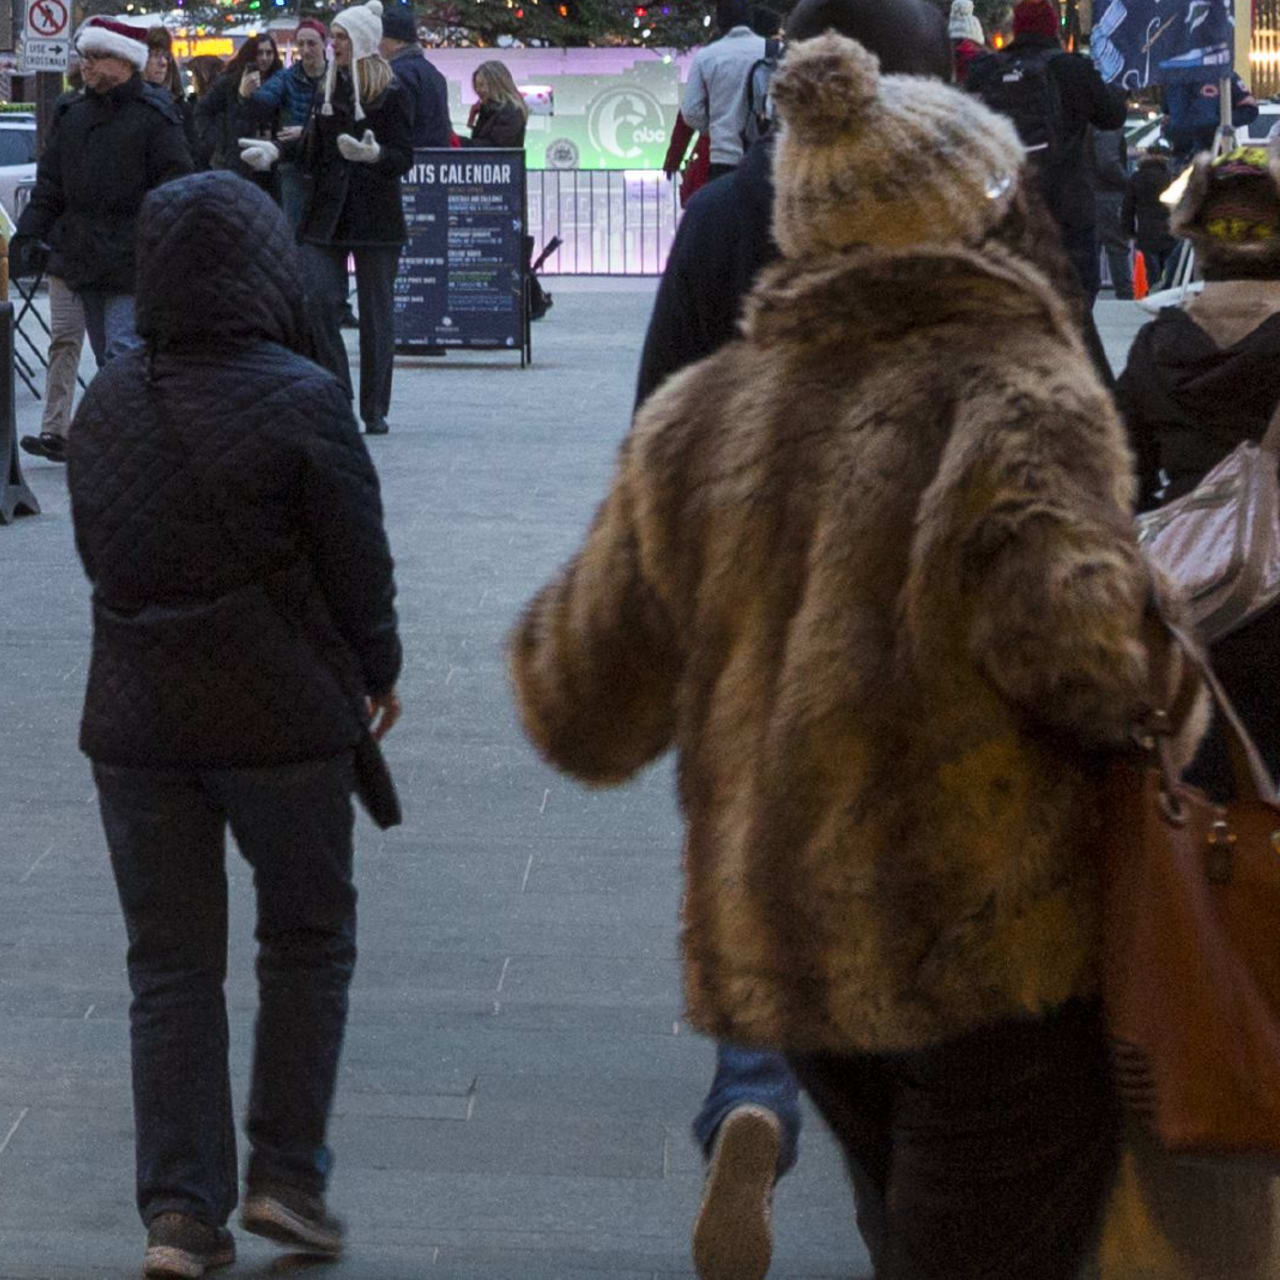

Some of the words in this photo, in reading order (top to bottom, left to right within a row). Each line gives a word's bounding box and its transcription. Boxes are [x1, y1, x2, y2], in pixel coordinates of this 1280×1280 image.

[28, 44, 46, 53] USE
[26, 56, 67, 65] CROSSWALK
[632, 125, 666, 144] abc
[439, 163, 512, 184] CALENDAR
